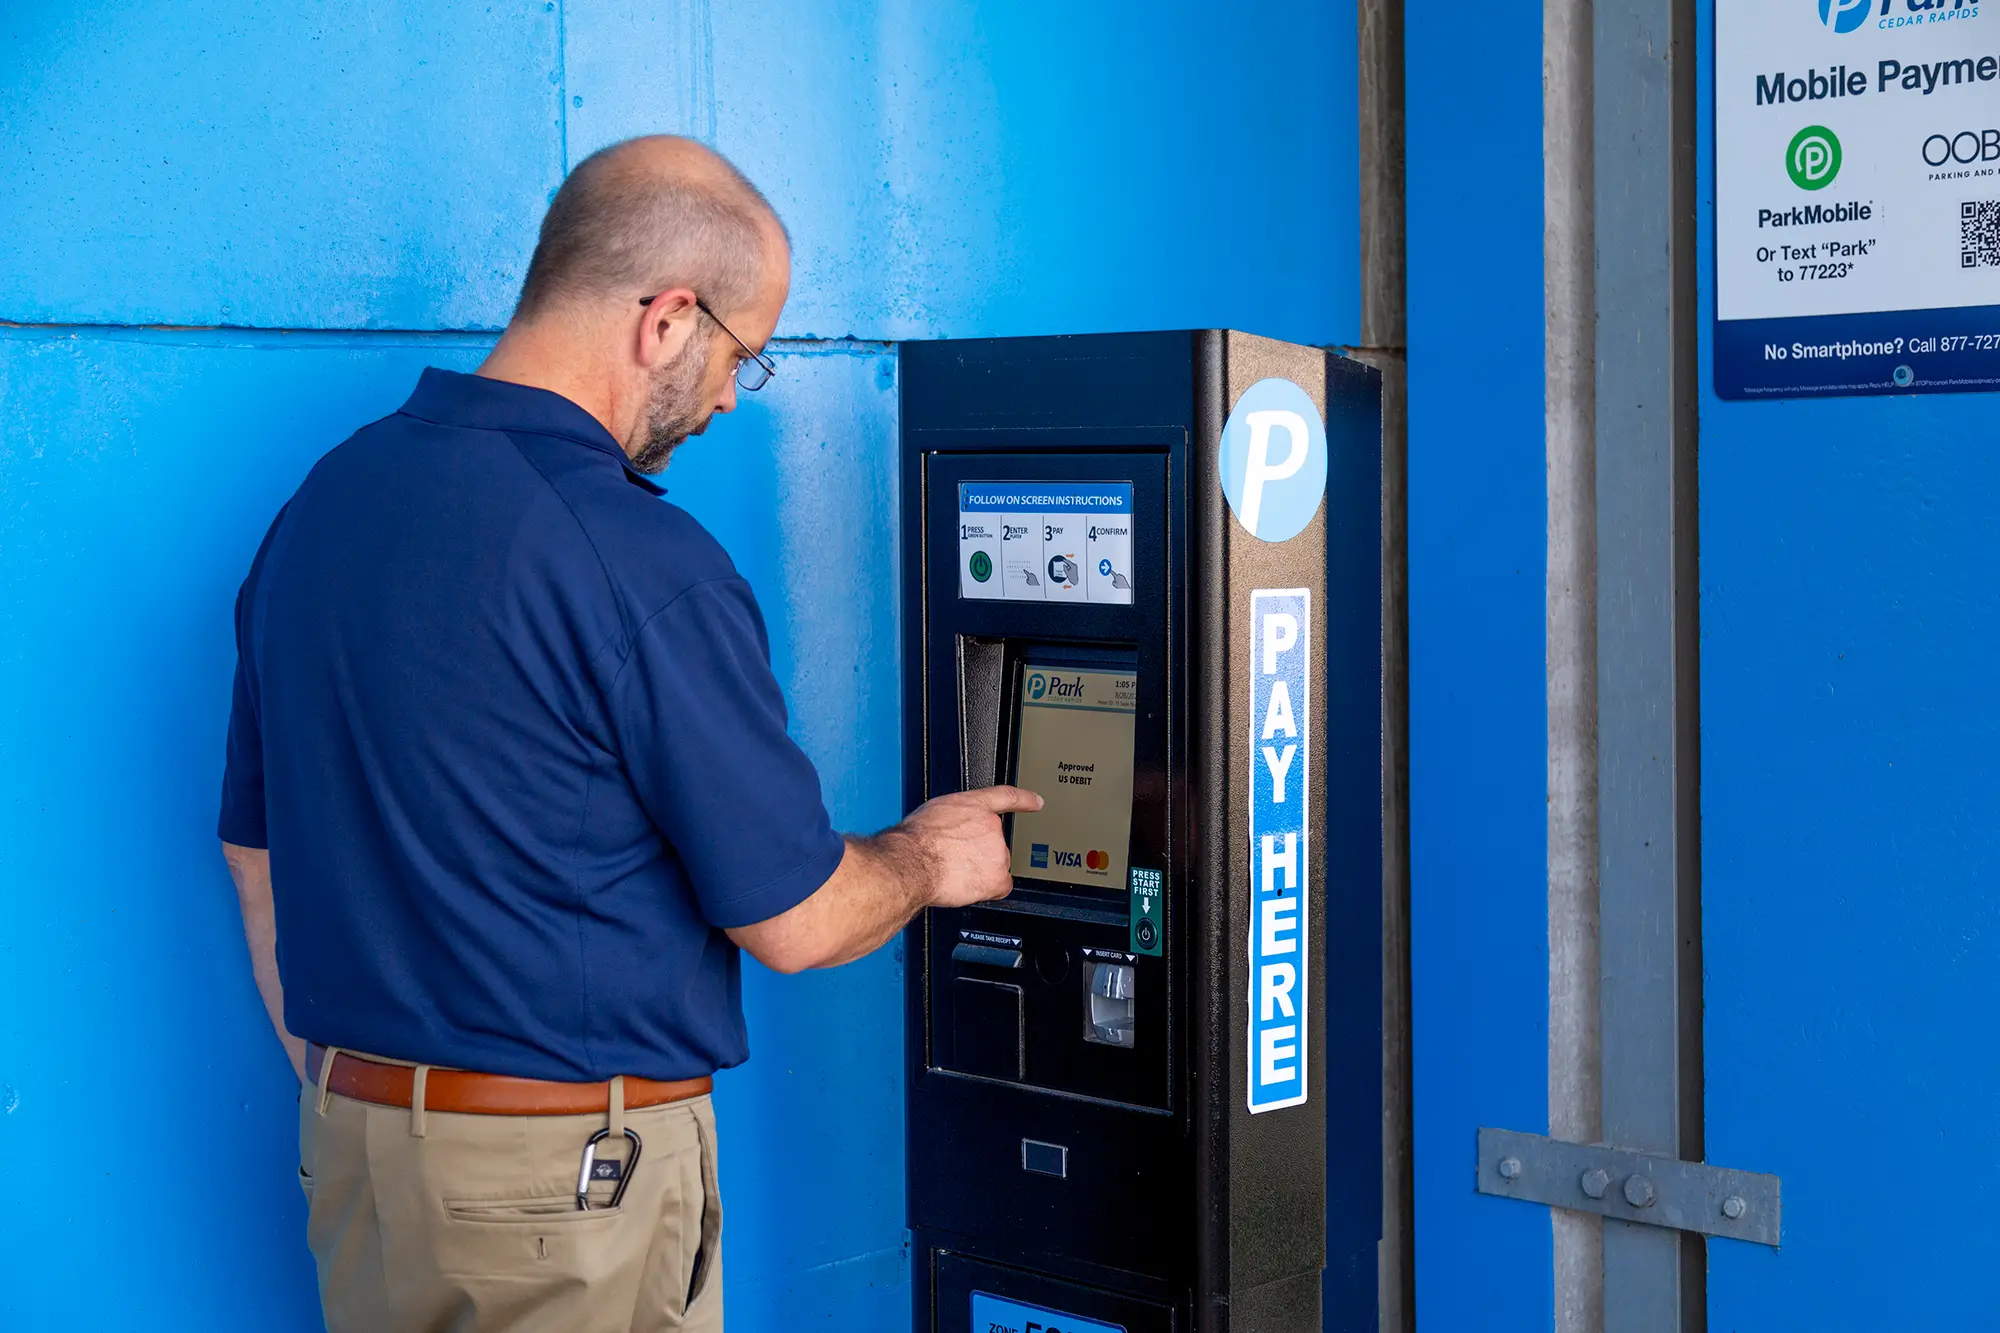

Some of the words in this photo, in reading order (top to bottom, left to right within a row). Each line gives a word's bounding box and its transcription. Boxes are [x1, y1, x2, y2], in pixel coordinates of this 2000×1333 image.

[1878, 14, 1924, 29] CEDAR
[1929, 7, 1979, 23] RAPIDS
[1756, 65, 1867, 106] Mobile
[1878, 55, 2000, 95] Payme
[1929, 171, 1970, 181] PARKING
[1974, 169, 1994, 177] AND
[1758, 201, 1872, 228] ParkMobile
[1756, 247, 1776, 263] Or
[1781, 244, 1816, 262] Text
[1821, 238, 1876, 258] “Park”
[1778, 267, 1794, 282] to
[1764, 343, 1787, 360] No
[1791, 338, 1903, 360] Smartphone?
[1909, 337, 1936, 353] Call
[969, 495, 1005, 505] FOLLOW
[1006, 495, 1020, 505] ON
[1021, 495, 1054, 505] SCREEN
[1055, 495, 1123, 506] INSTRUCTIONS
[961, 524, 968, 540] 1
[968, 526, 984, 534] PRESS
[1003, 525, 1010, 541] 2
[1010, 526, 1028, 534] ENTER
[1045, 525, 1053, 541] 3
[1053, 527, 1063, 535] PAY
[1088, 526, 1097, 542] 4
[1097, 527, 1128, 535] CONFIRM
[1048, 677, 1084, 697] Park
[1116, 680, 1130, 688] 1:05
[1261, 613, 1298, 804] PAY
[1058, 761, 1095, 772] Approved
[1058, 775, 1068, 784] US
[1069, 776, 1092, 785] DEBIT
[1053, 851, 1082, 868] VISA
[1133, 869, 1160, 881] PRESS
[1133, 878, 1160, 889] START
[1134, 886, 1159, 897] FIRST
[970, 933, 985, 941] PLEASE
[995, 936, 1011, 944] RECEIPT
[1095, 950, 1110, 958] INSERT
[1110, 951, 1122, 960] CARD
[1260, 832, 1297, 1086] HERE
